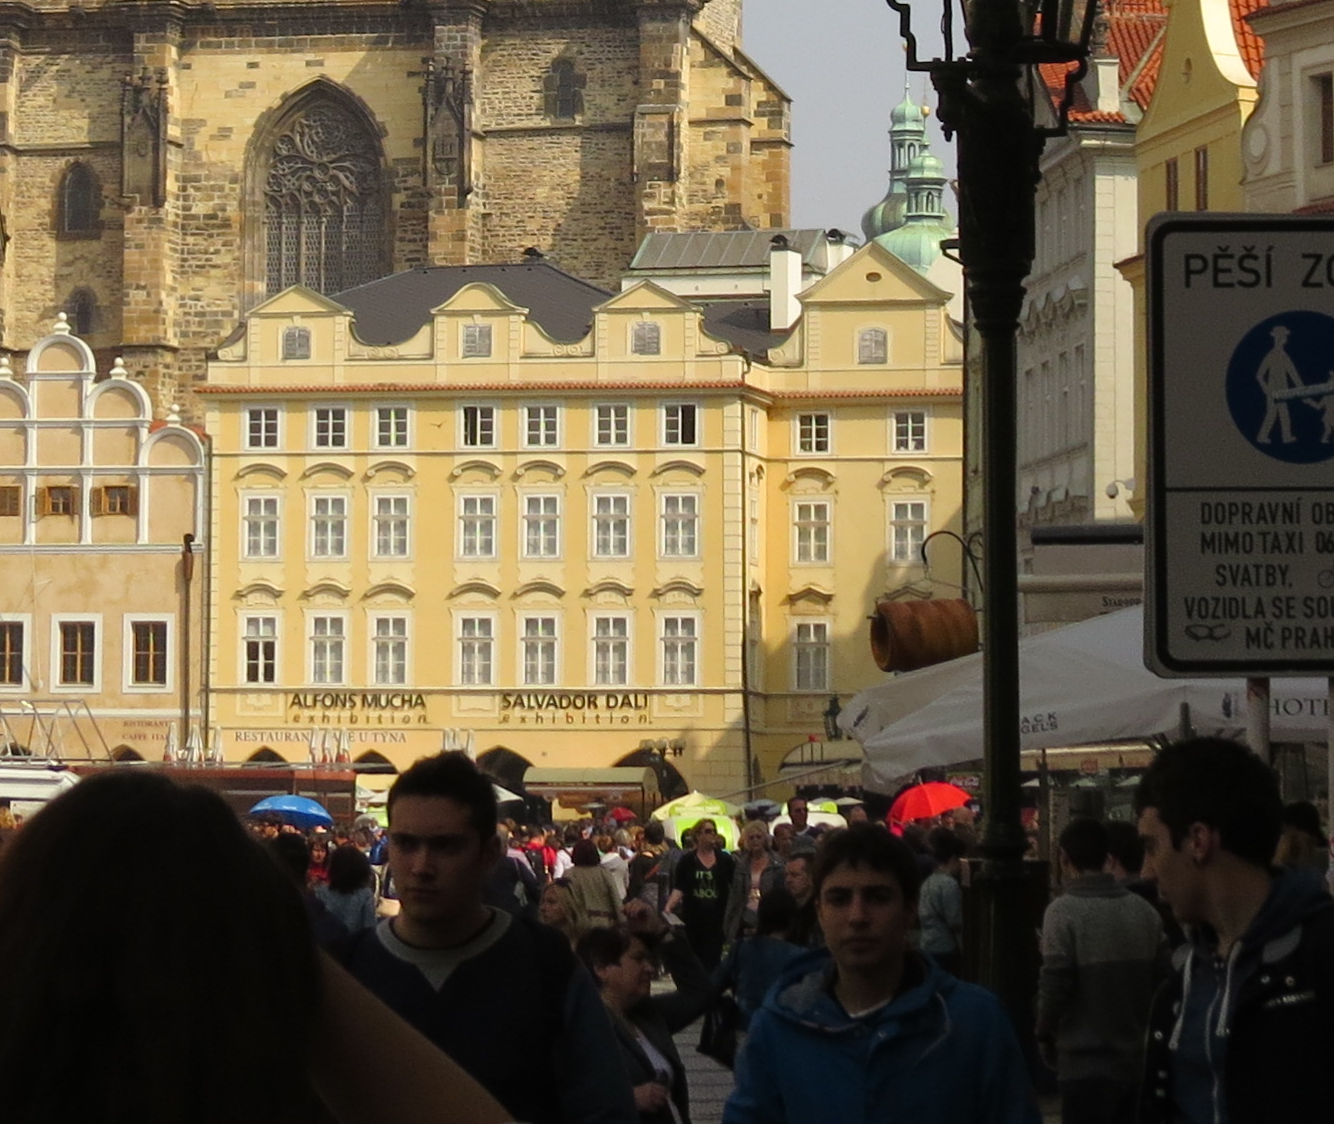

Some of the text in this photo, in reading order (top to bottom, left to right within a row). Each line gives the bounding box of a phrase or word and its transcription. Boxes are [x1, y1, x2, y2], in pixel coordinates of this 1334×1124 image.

[1183, 245, 1276, 290] PĚŠÍ
[1200, 497, 1302, 526] DOPRAVNÍ
[1200, 532, 1255, 555] MIMO
[1256, 531, 1305, 555] TAXI
[1184, 596, 1267, 620] VOZIDLA
[1271, 596, 1296, 620] SE
[1245, 620, 1275, 650] MČ
[289, 692, 427, 710] ALFONS MUCHA
[501, 692, 598, 711] SALVADOR
[1267, 698, 1330, 717] HOT
[1020, 712, 1057, 725] ACK
[1020, 720, 1059, 736] GEL'S
[234, 731, 311, 743] RESTAURAN
